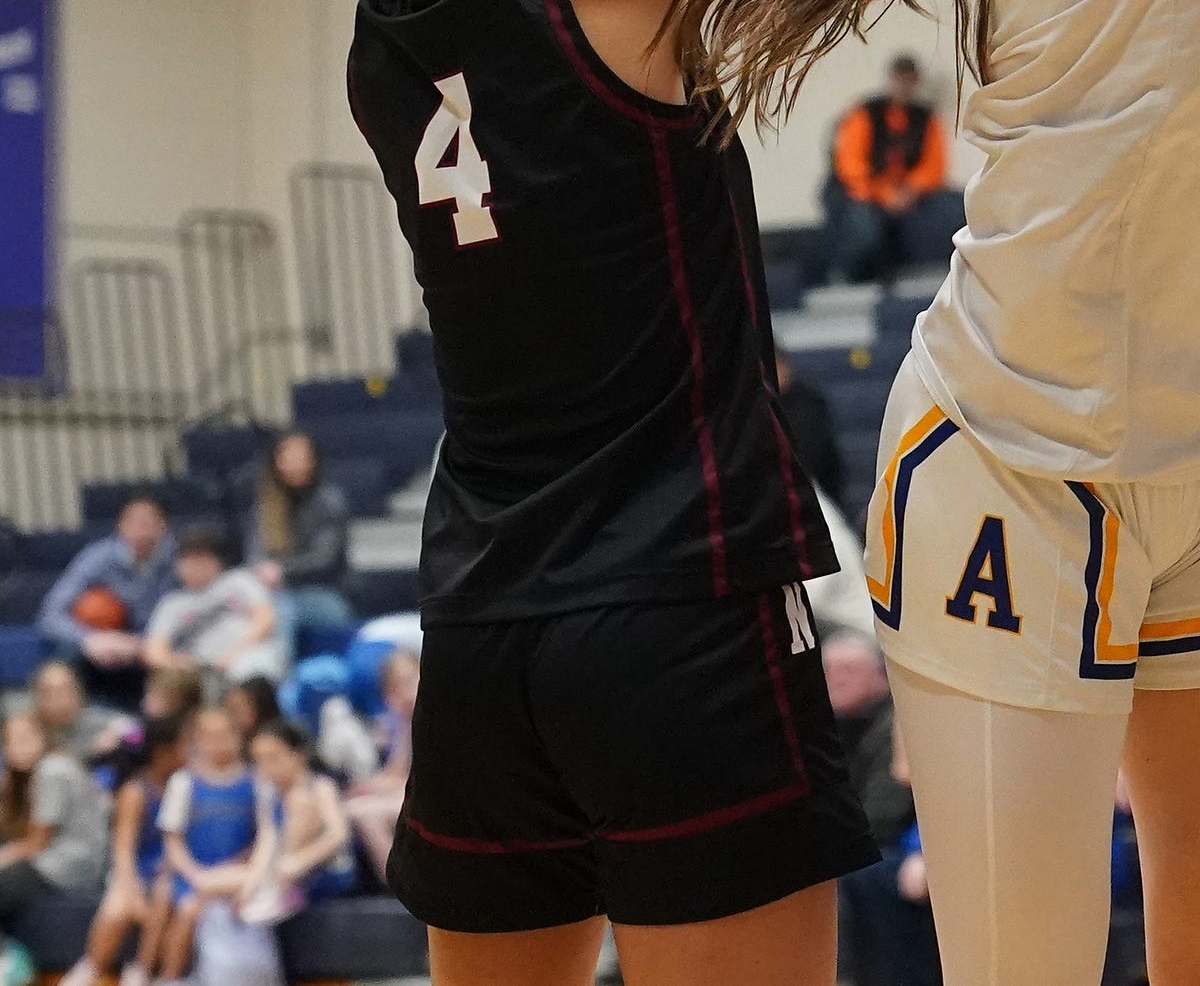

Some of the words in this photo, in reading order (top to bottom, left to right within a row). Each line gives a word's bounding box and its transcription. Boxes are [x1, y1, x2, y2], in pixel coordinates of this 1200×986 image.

[412, 70, 500, 247] 4
[780, 581, 816, 655] N
[943, 513, 1023, 636] A
